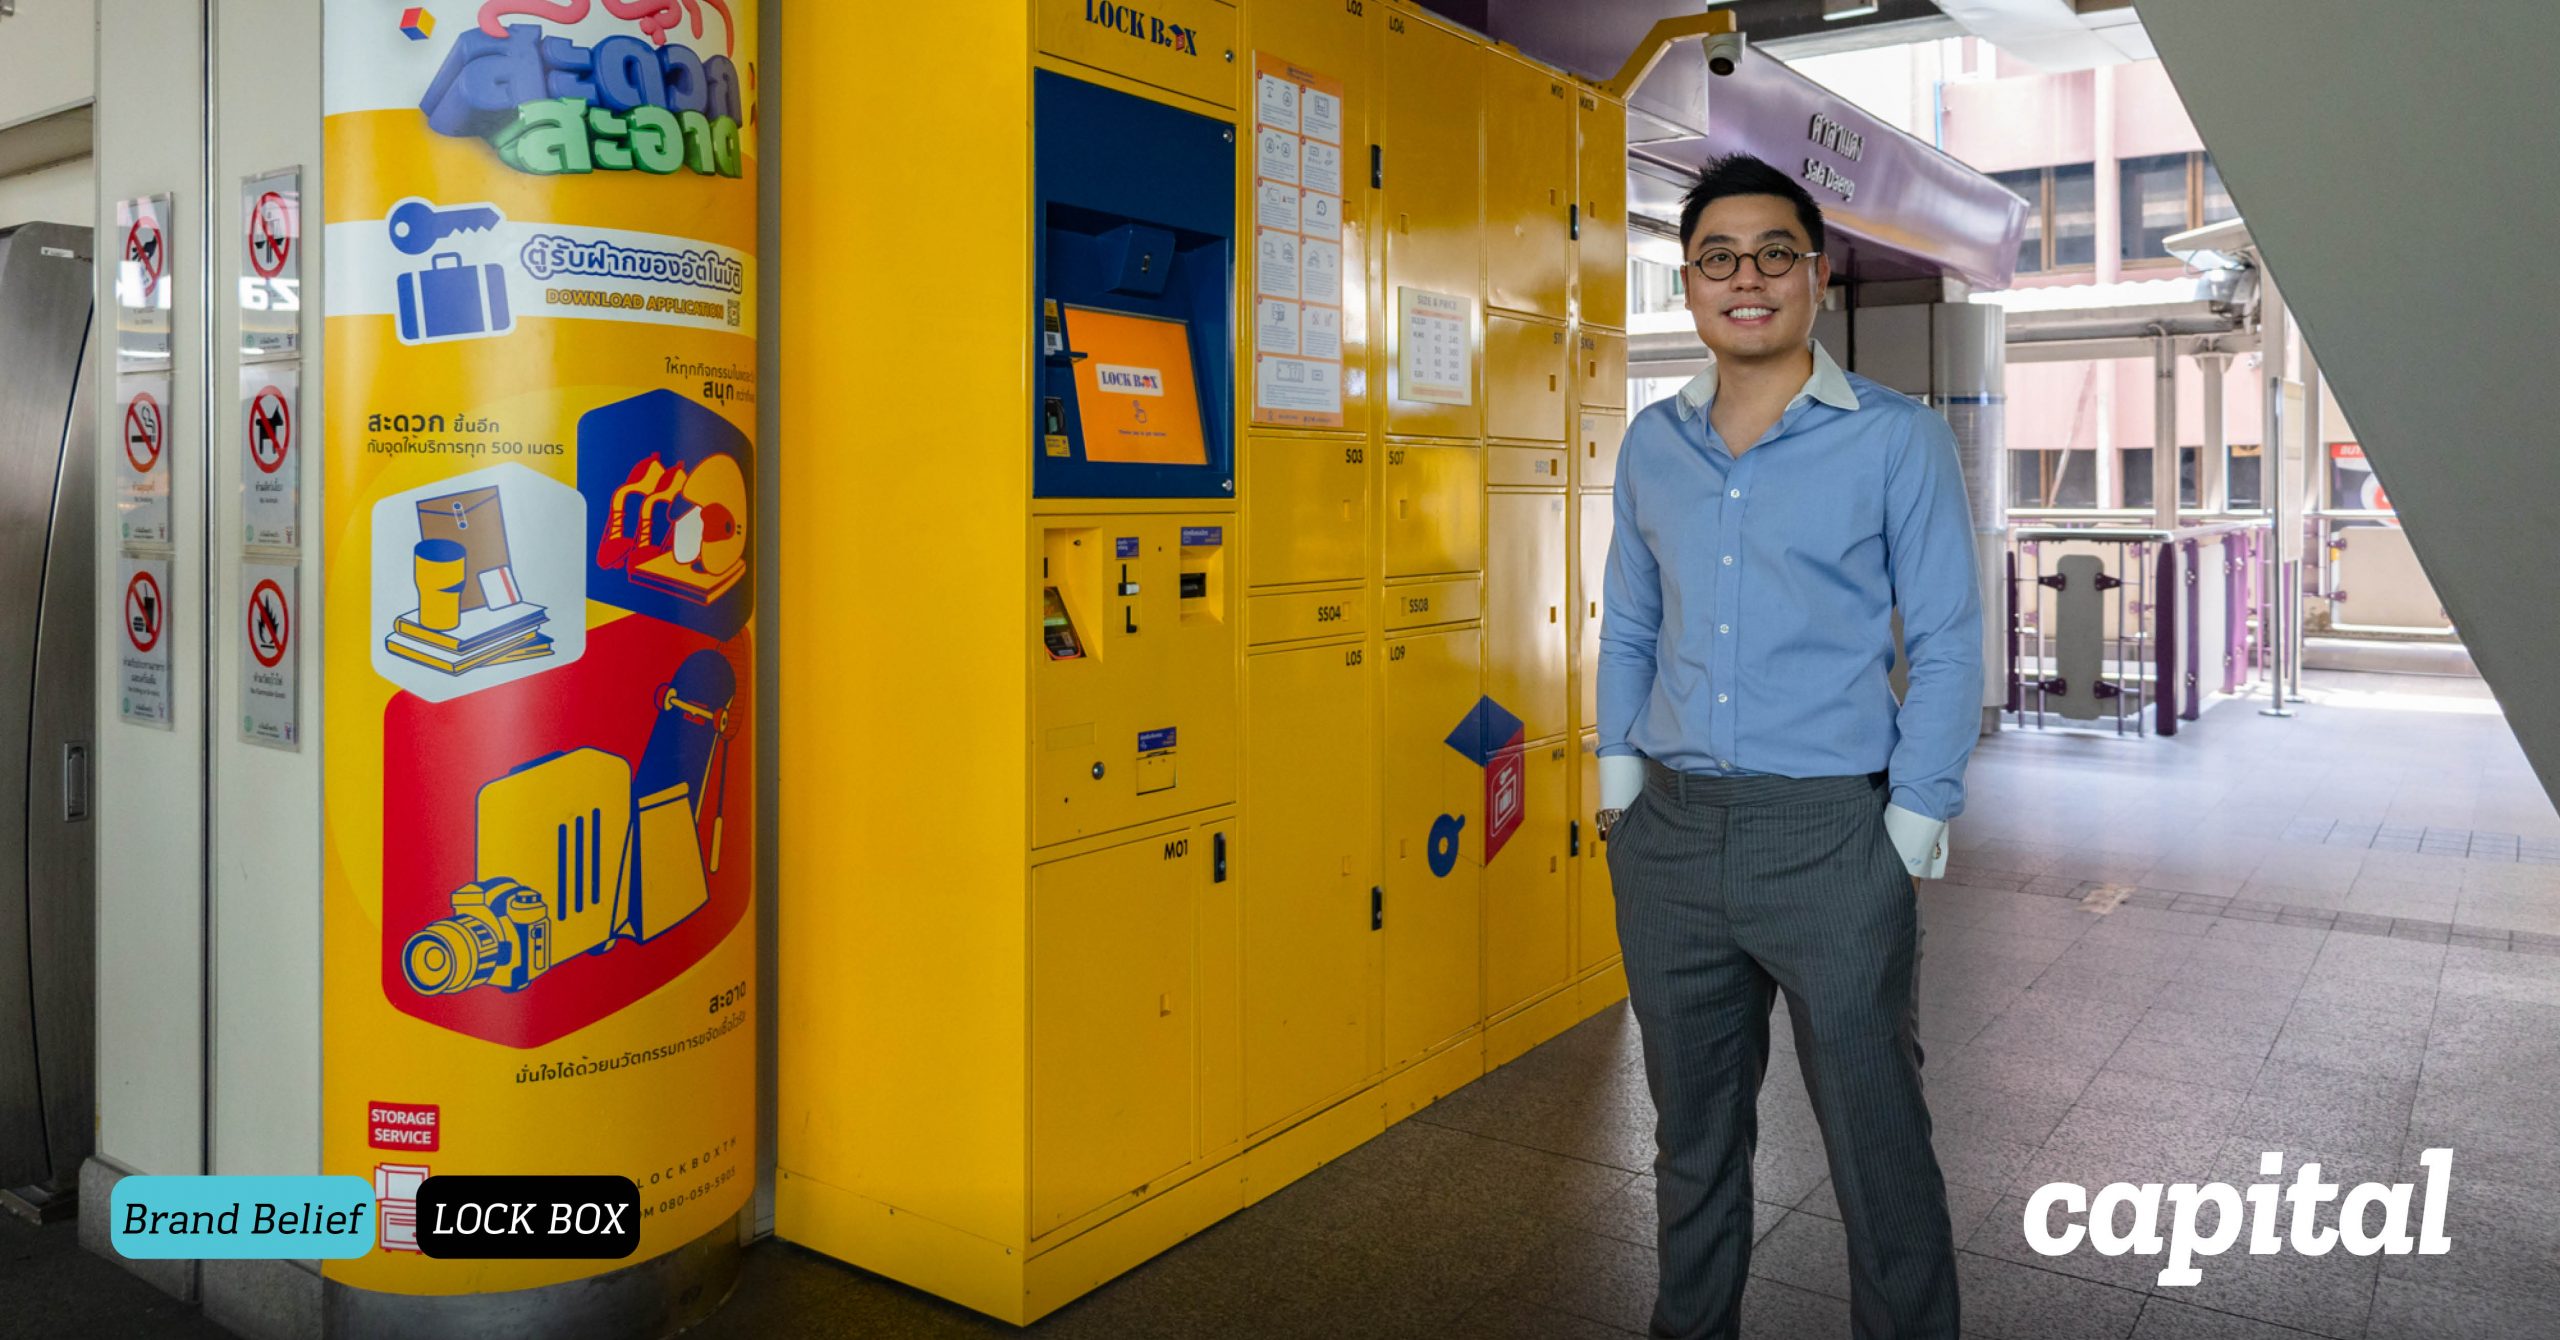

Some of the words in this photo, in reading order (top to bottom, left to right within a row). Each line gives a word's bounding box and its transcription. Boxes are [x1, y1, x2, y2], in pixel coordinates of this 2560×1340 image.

[1085, 0, 1145, 40] LOCK
[422, 24, 742, 137] สะดวก
[498, 97, 742, 178] สะอาด
[1803, 158, 1826, 185] Sala
[523, 238, 742, 292] ตู้รับฝากของอัตโนมัติ
[546, 288, 645, 310] DOWNLOAD
[646, 296, 724, 320] APPLICATION
[1101, 371, 1131, 387] LOCK
[703, 380, 734, 407] สนุก
[368, 413, 445, 433] สะดวก
[454, 413, 500, 433] ขึ้นอีก
[367, 436, 486, 459] กับจุดให้บริการทุก
[492, 441, 523, 454] 500
[528, 442, 564, 455] เมตร
[1346, 449, 1363, 463] S03
[1389, 451, 1404, 465] S07
[1318, 605, 1341, 622] SS04
[1409, 598, 1429, 614] SS08
[1345, 650, 1362, 666] L05
[1390, 645, 1406, 661] L09
[1164, 839, 1188, 860] M01
[709, 980, 747, 1014] สะอาด
[371, 1108, 436, 1126] STORAGE
[374, 1127, 432, 1145] SERVICE
